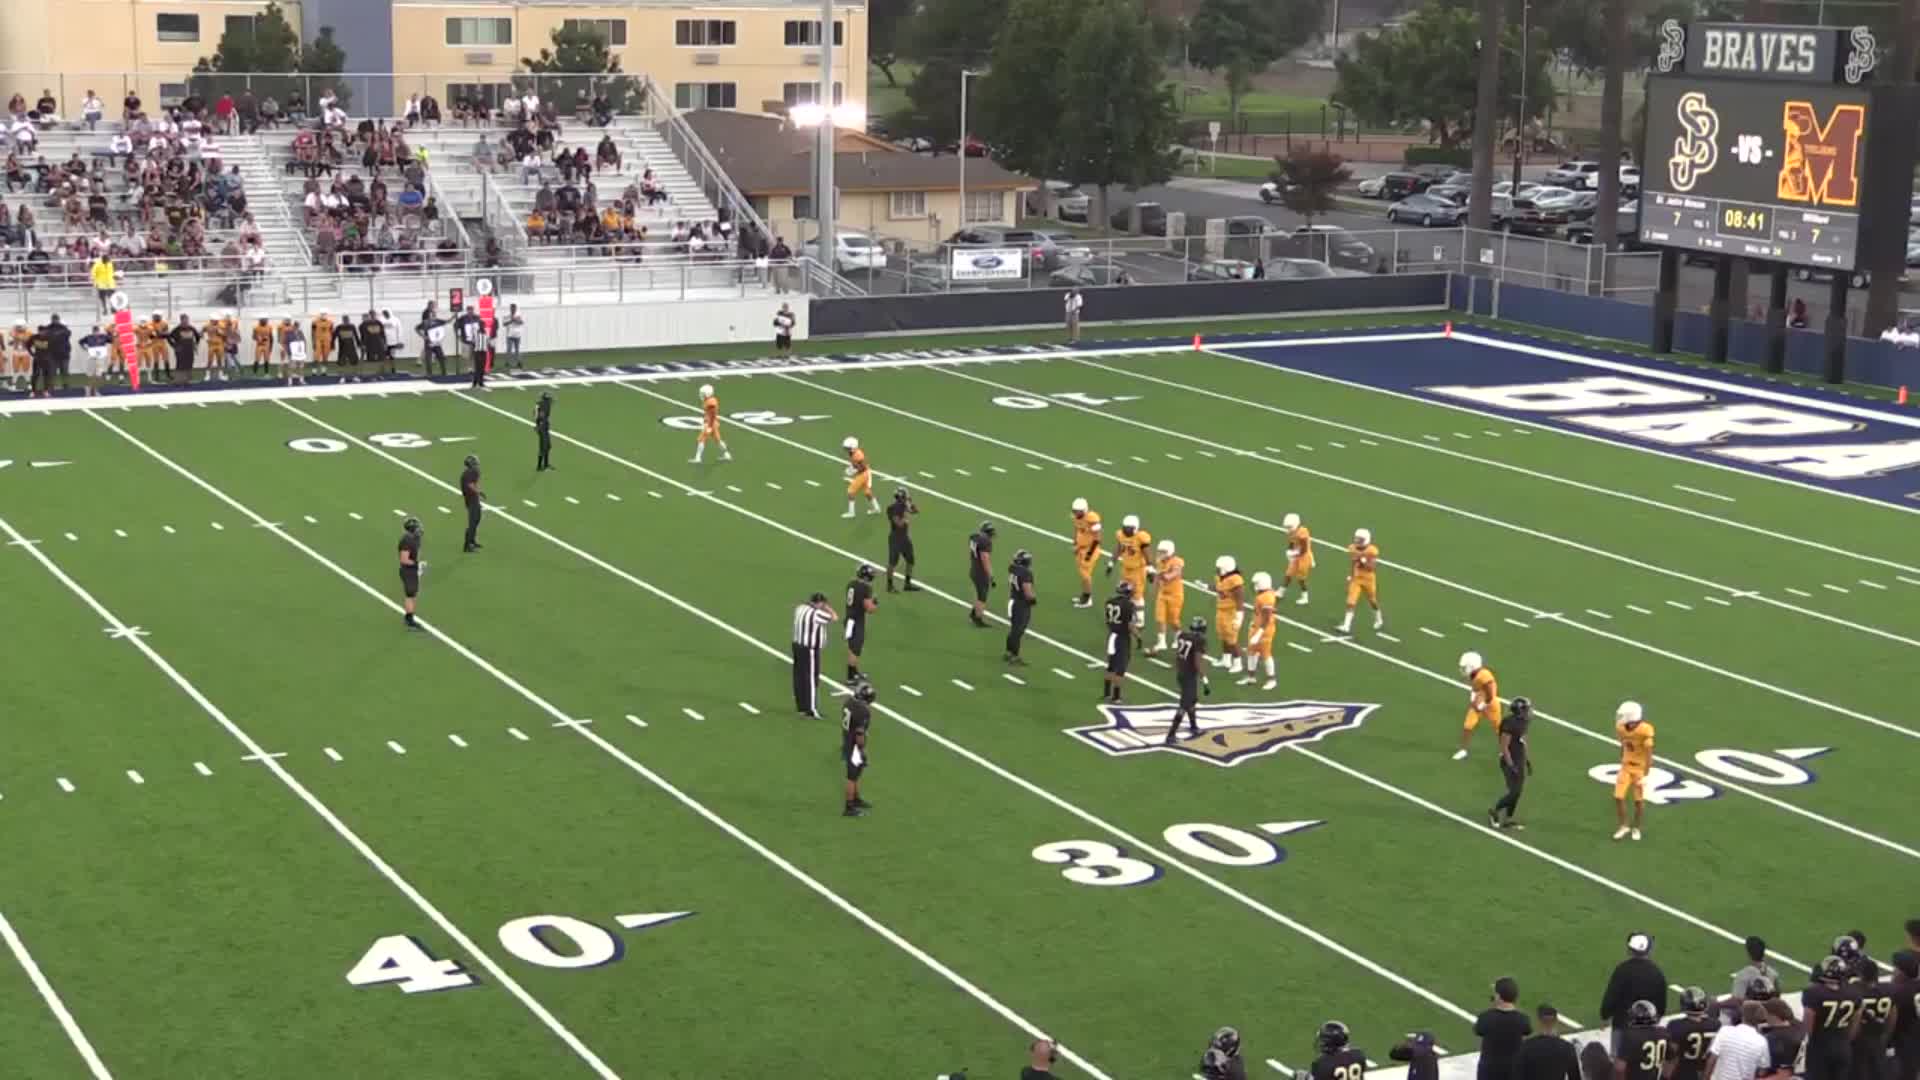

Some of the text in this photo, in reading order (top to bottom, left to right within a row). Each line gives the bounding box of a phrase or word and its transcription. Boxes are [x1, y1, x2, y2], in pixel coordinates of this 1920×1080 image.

[1704, 31, 1816, 72] BRAVES
[1777, 101, 1864, 206] M
[1673, 211, 1681, 227] 7
[1725, 209, 1764, 231] 08:41
[1811, 228, 1820, 244] 7
[1418, 376, 1920, 484] BRA
[1032, 823, 1286, 886] 30
[346, 914, 624, 994] 40
[1822, 1000, 1855, 1028] 72
[1859, 996, 1892, 1022] 59
[1640, 1038, 1667, 1071] 30
